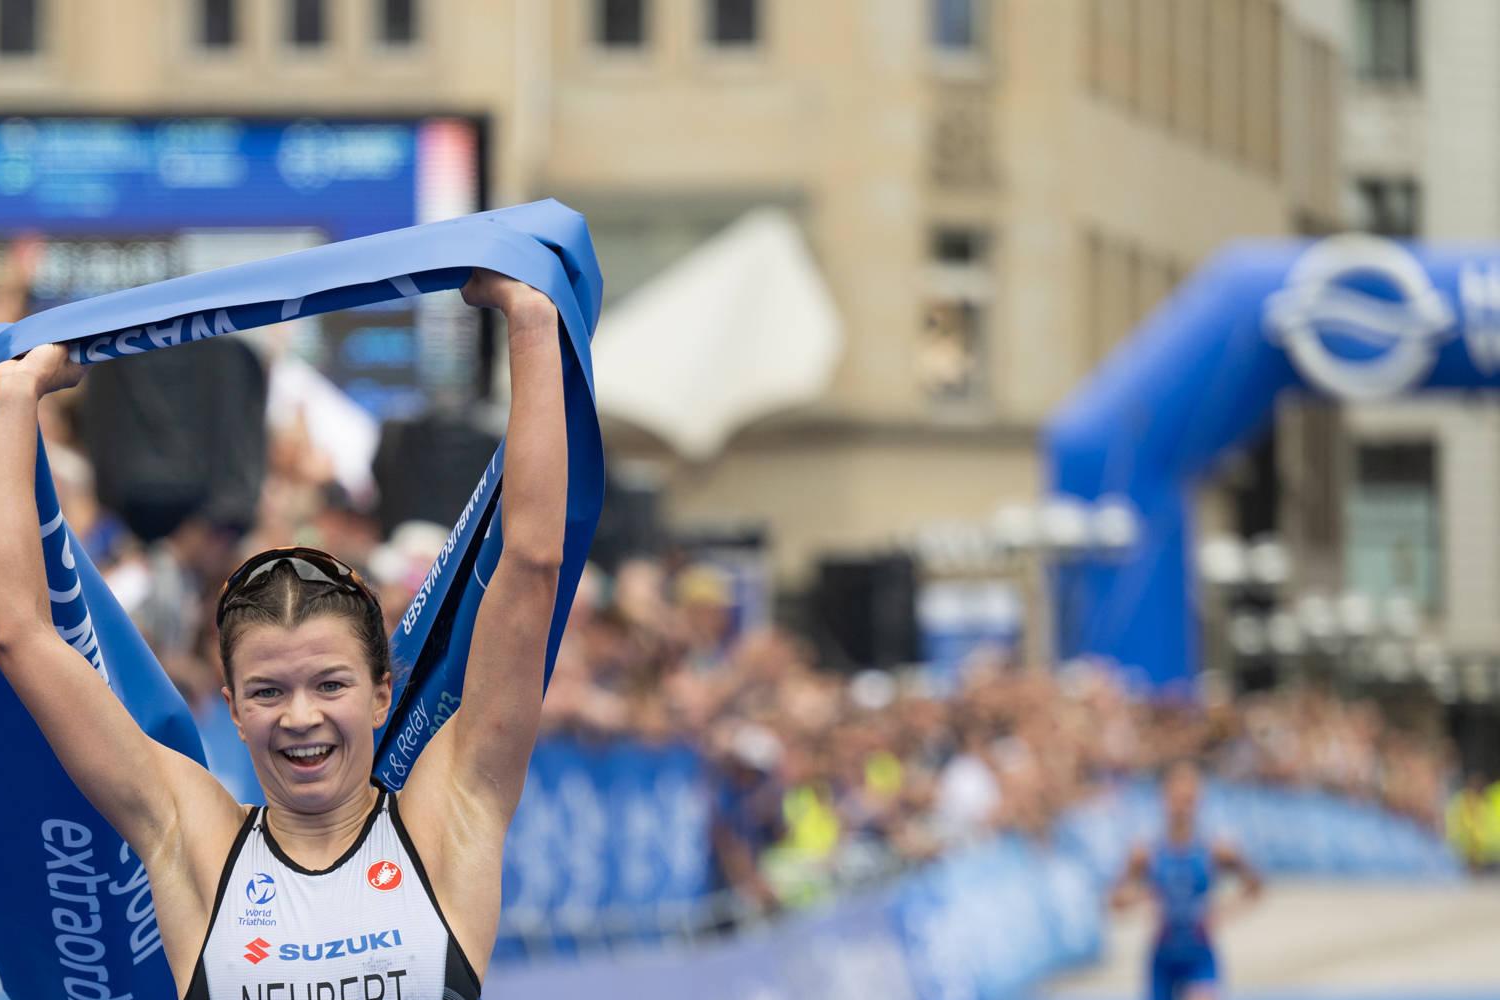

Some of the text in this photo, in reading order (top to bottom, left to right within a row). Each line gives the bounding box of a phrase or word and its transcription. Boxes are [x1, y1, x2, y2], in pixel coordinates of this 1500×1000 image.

[402, 469, 488, 636] HAMBURG WASSER
[396, 697, 430, 760] Relay
[389, 752, 408, 777] &
[238, 917, 277, 927] Triathlon
[245, 908, 272, 918] World
[279, 929, 403, 962] SUZUKI
